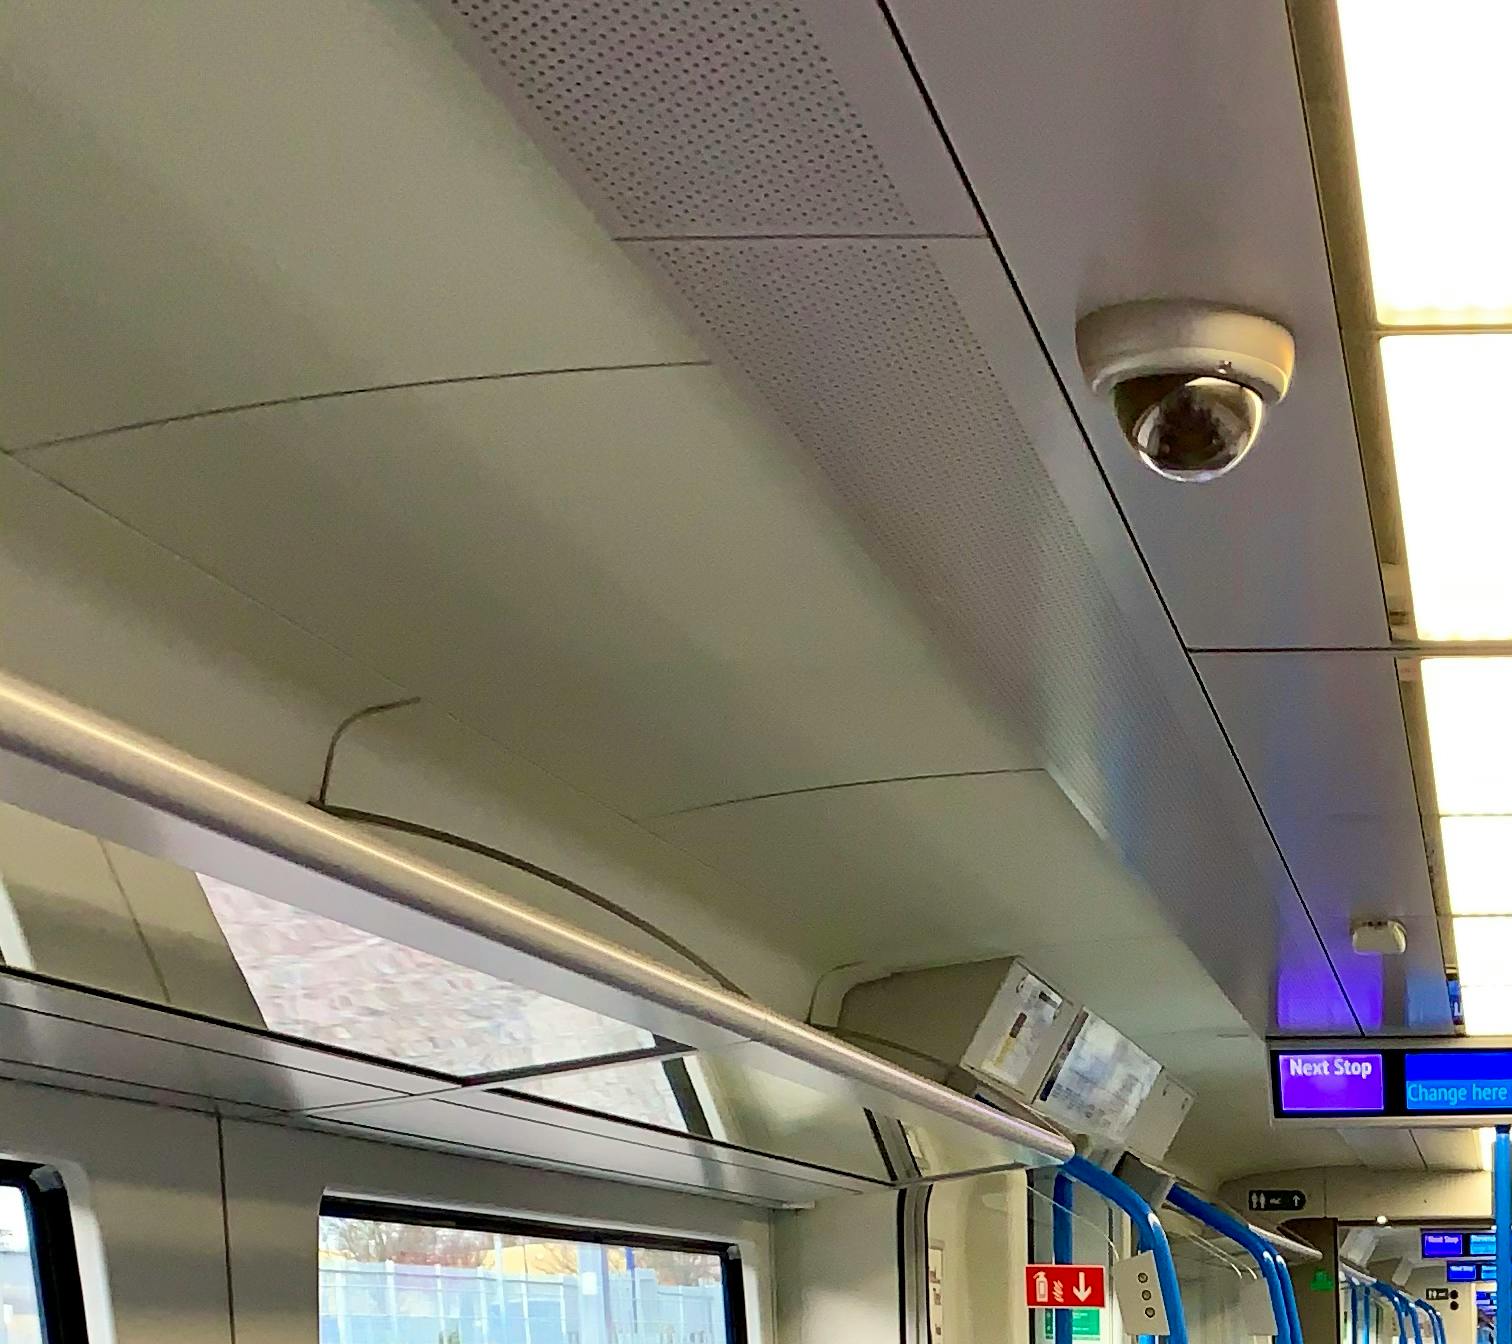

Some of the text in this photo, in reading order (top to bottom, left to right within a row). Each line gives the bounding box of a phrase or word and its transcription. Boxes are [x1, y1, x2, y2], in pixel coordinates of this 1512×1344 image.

[1290, 1058, 1372, 1079] Next Stop
[1407, 1083, 1467, 1105] Change
[1472, 1083, 1508, 1101] here
